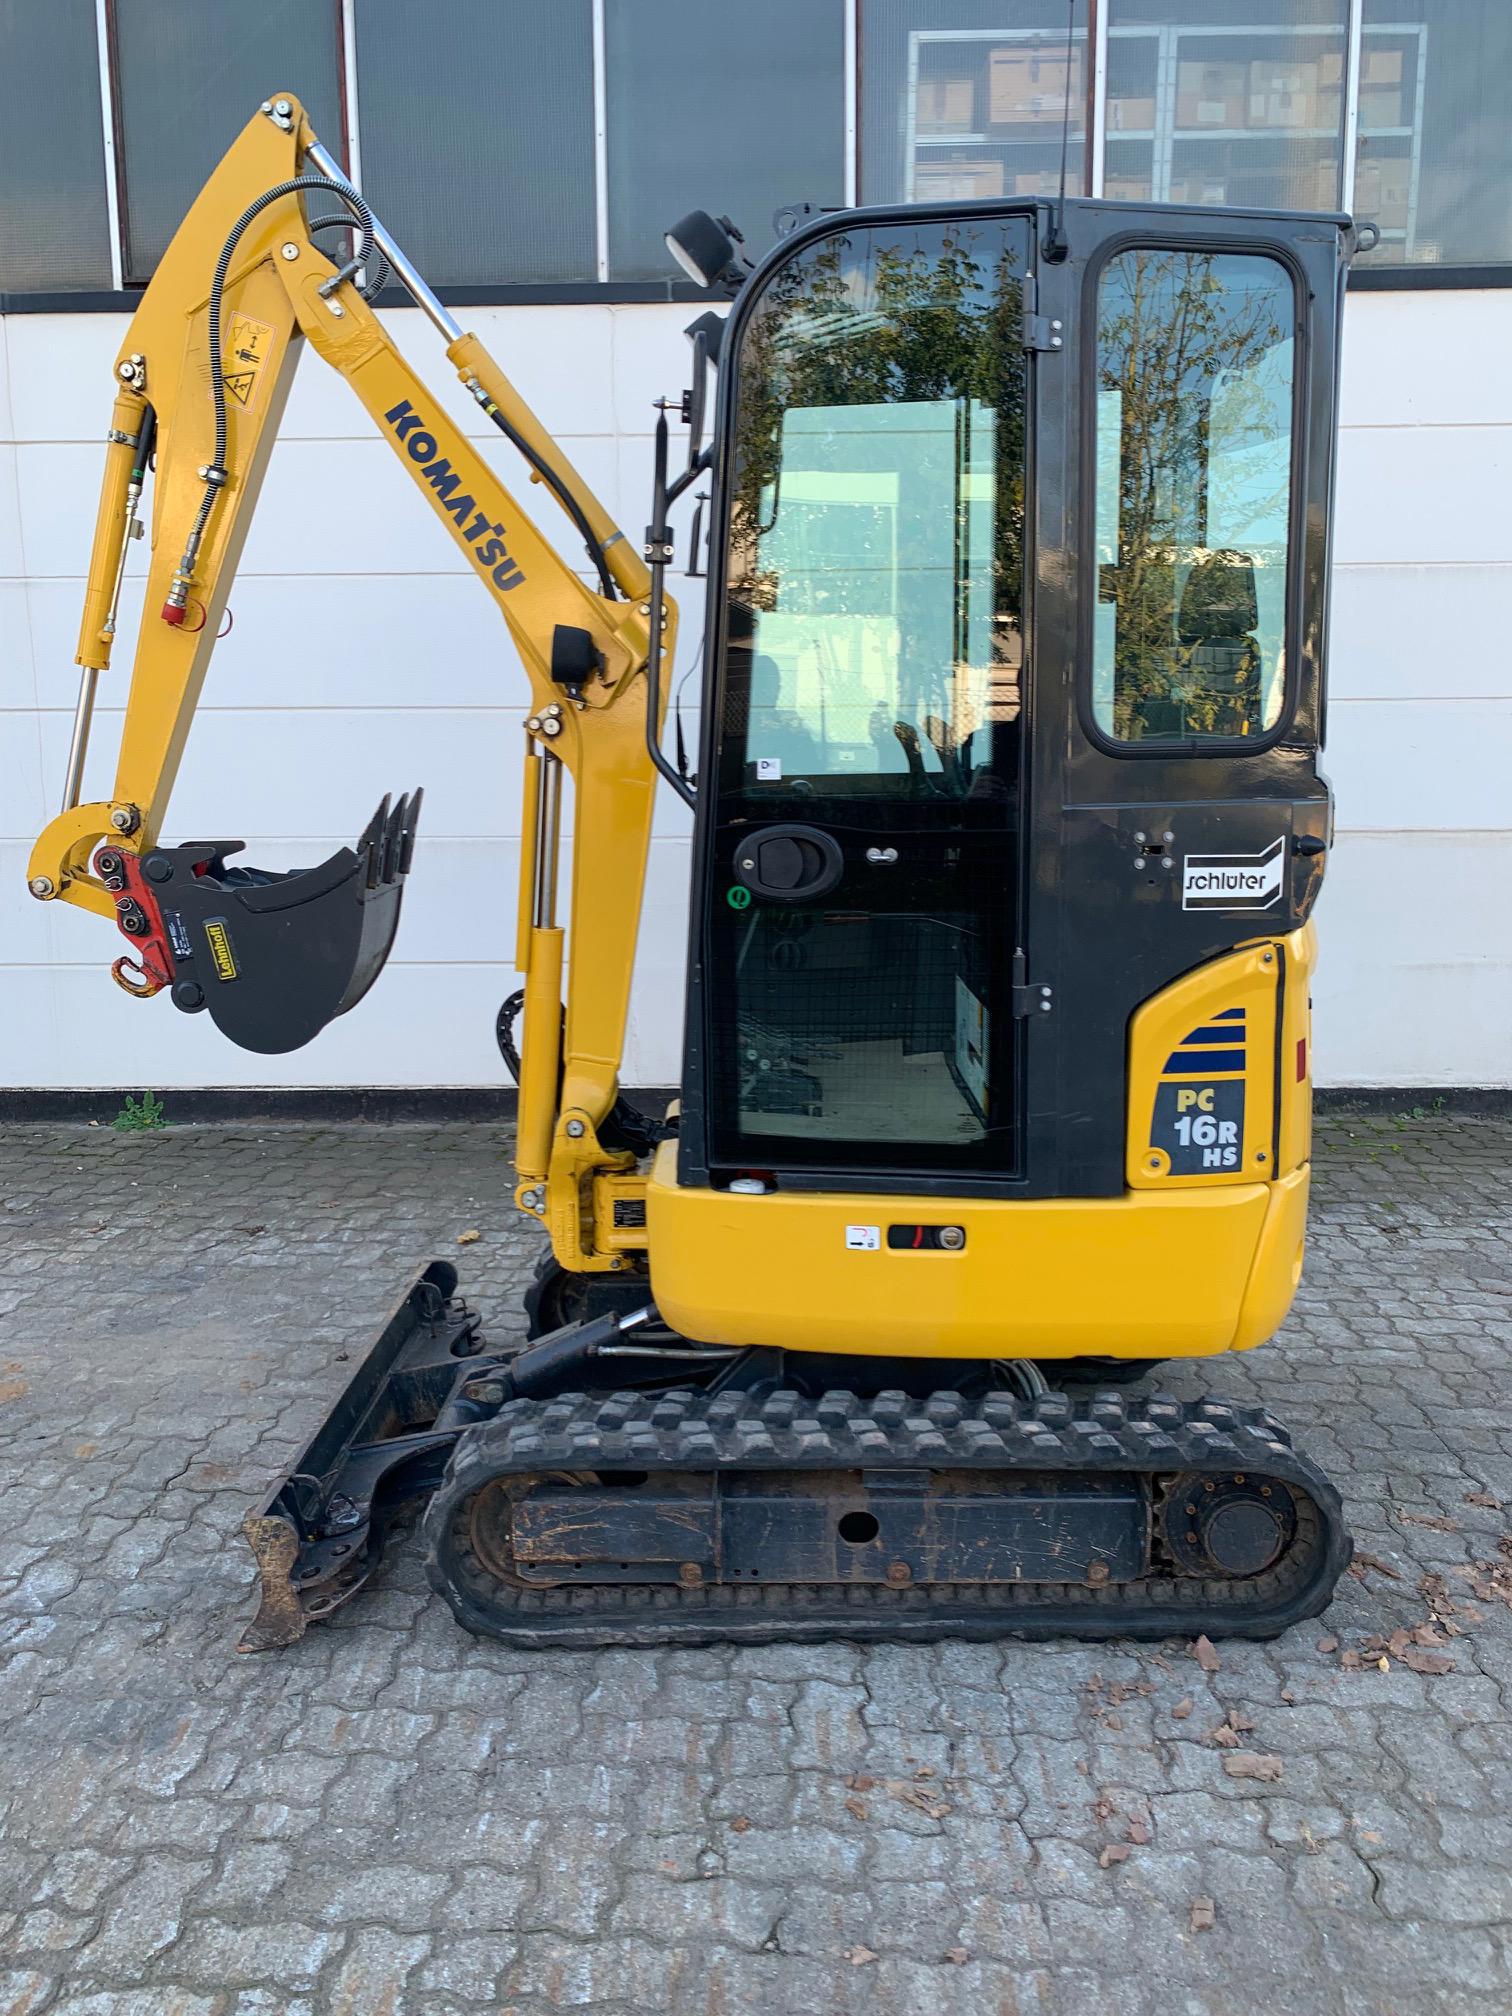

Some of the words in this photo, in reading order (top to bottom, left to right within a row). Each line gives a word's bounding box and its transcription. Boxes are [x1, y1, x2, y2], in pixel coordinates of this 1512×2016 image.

[384, 399, 527, 592] KOMATSU
[207, 925, 233, 978] Lehnhoff
[1176, 1088, 1215, 1112] PC
[1173, 1114, 1239, 1146] 16R
[1202, 1146, 1238, 1168] HS
